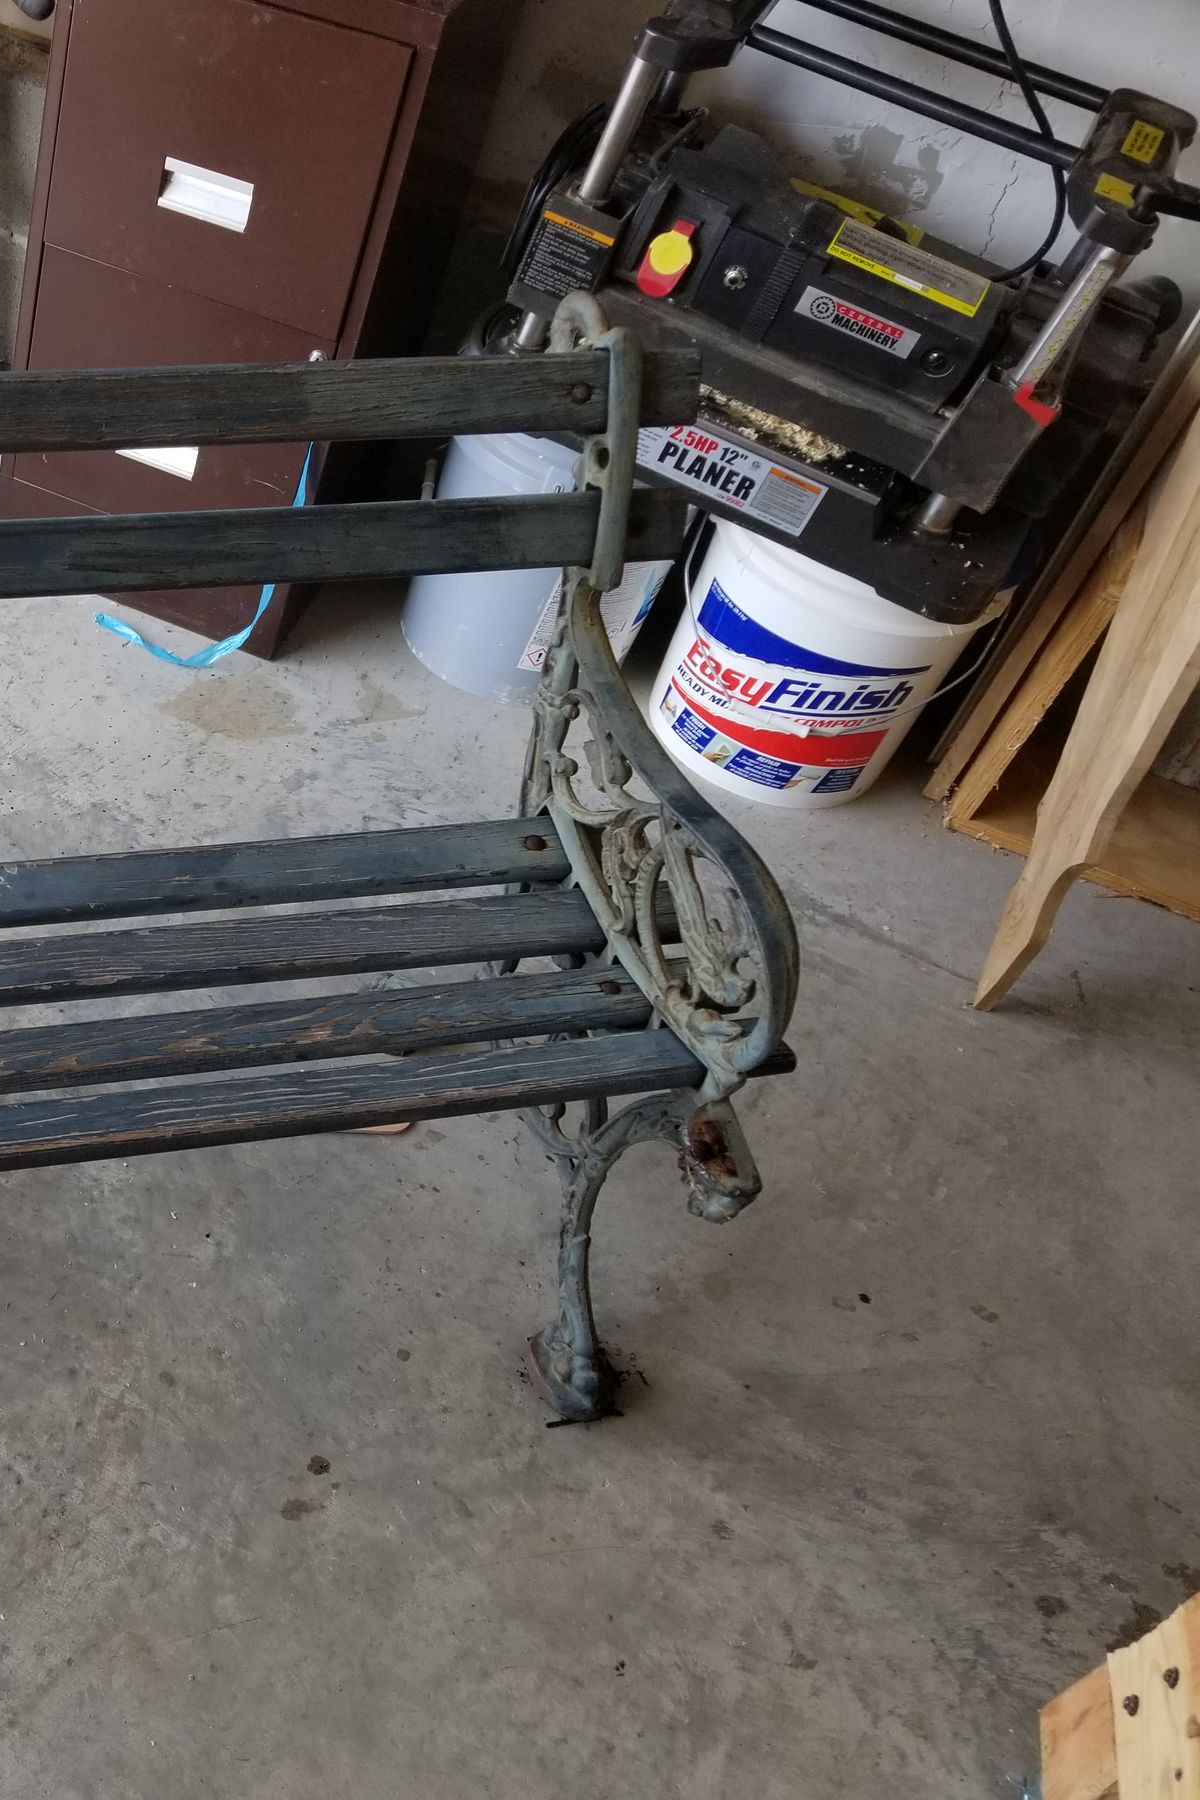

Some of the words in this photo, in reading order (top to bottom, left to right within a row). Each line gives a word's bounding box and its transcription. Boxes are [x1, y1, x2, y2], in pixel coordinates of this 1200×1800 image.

[831, 313, 899, 350] MACHINERY
[839, 306, 902, 339] CENTRAL
[669, 425, 720, 455] 2.5HP
[719, 447, 749, 466] 12"
[657, 441, 757, 501] PLANER
[677, 664, 710, 697] READY
[756, 756, 782, 768] REPAIR
